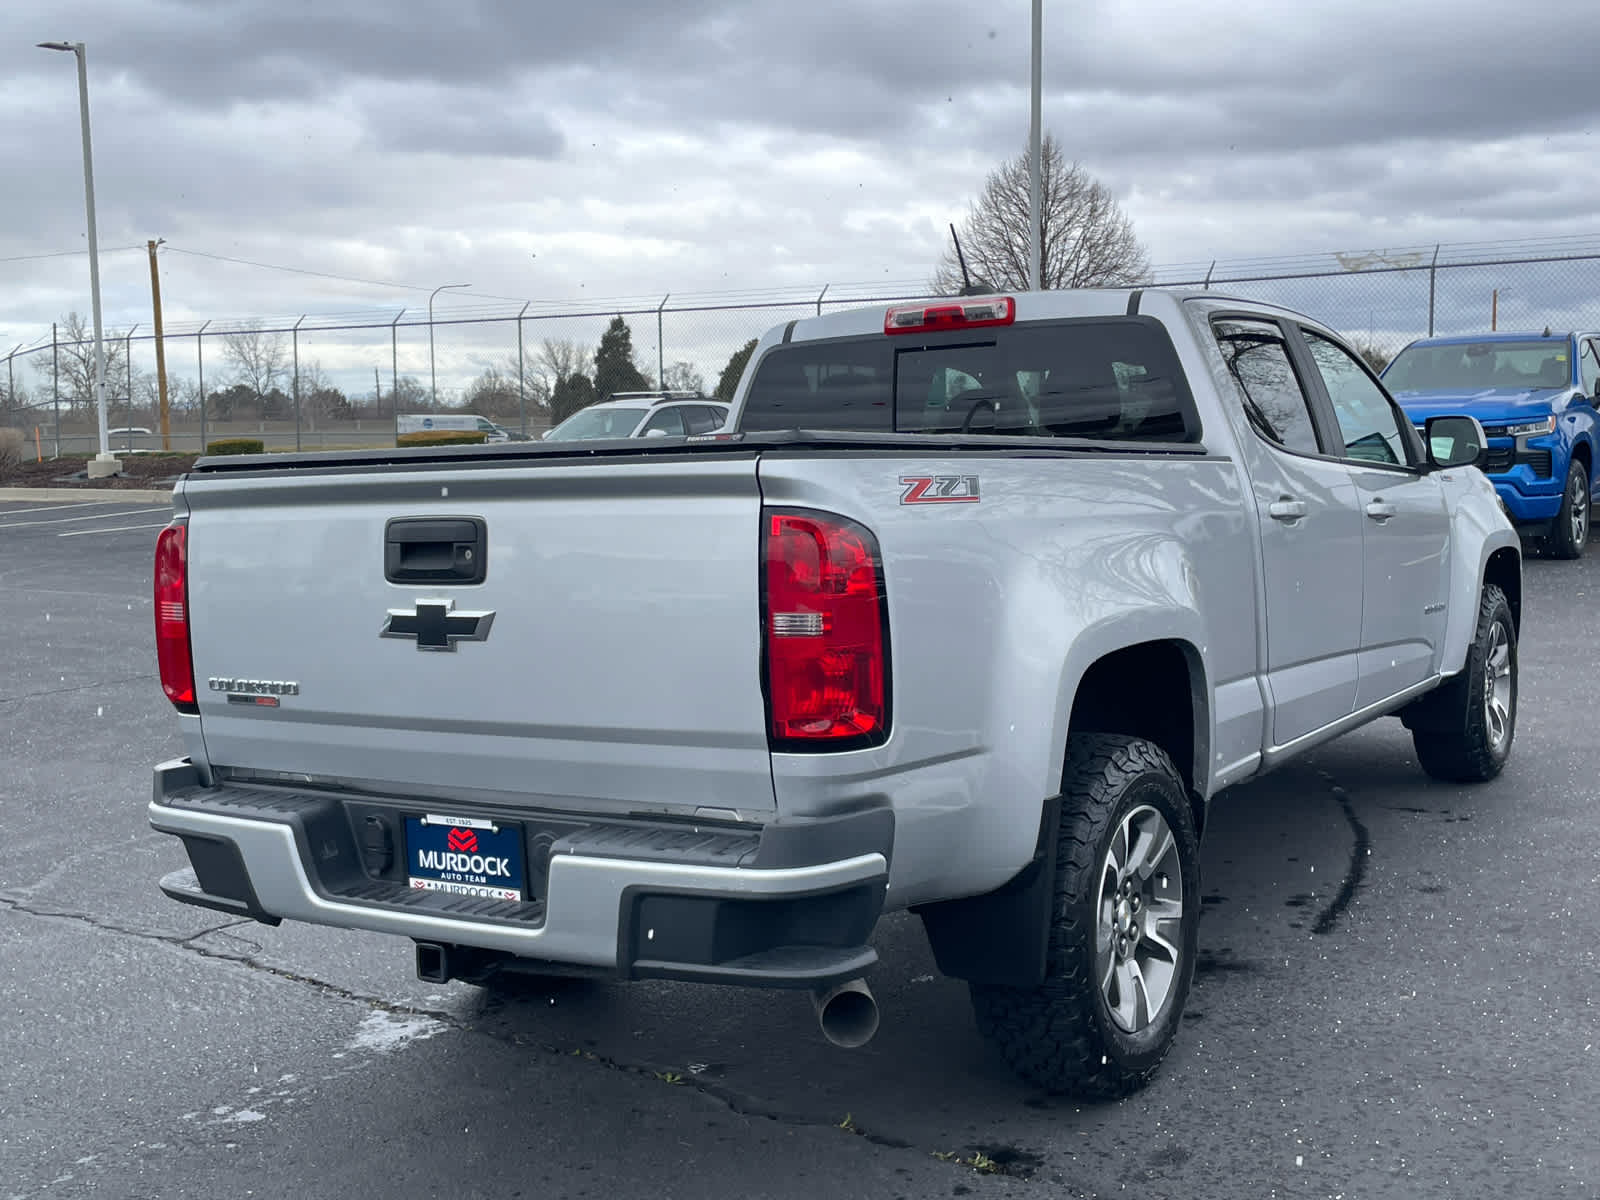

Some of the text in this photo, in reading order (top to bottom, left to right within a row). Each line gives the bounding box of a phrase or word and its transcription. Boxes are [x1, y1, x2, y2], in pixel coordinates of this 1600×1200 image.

[899, 475, 980, 505] Z71
[208, 677, 299, 696] COLORADO
[419, 849, 511, 877] MURDOCK
[441, 872, 487, 883] AUTO TEAM
[433, 882, 495, 897] MURDOCK
